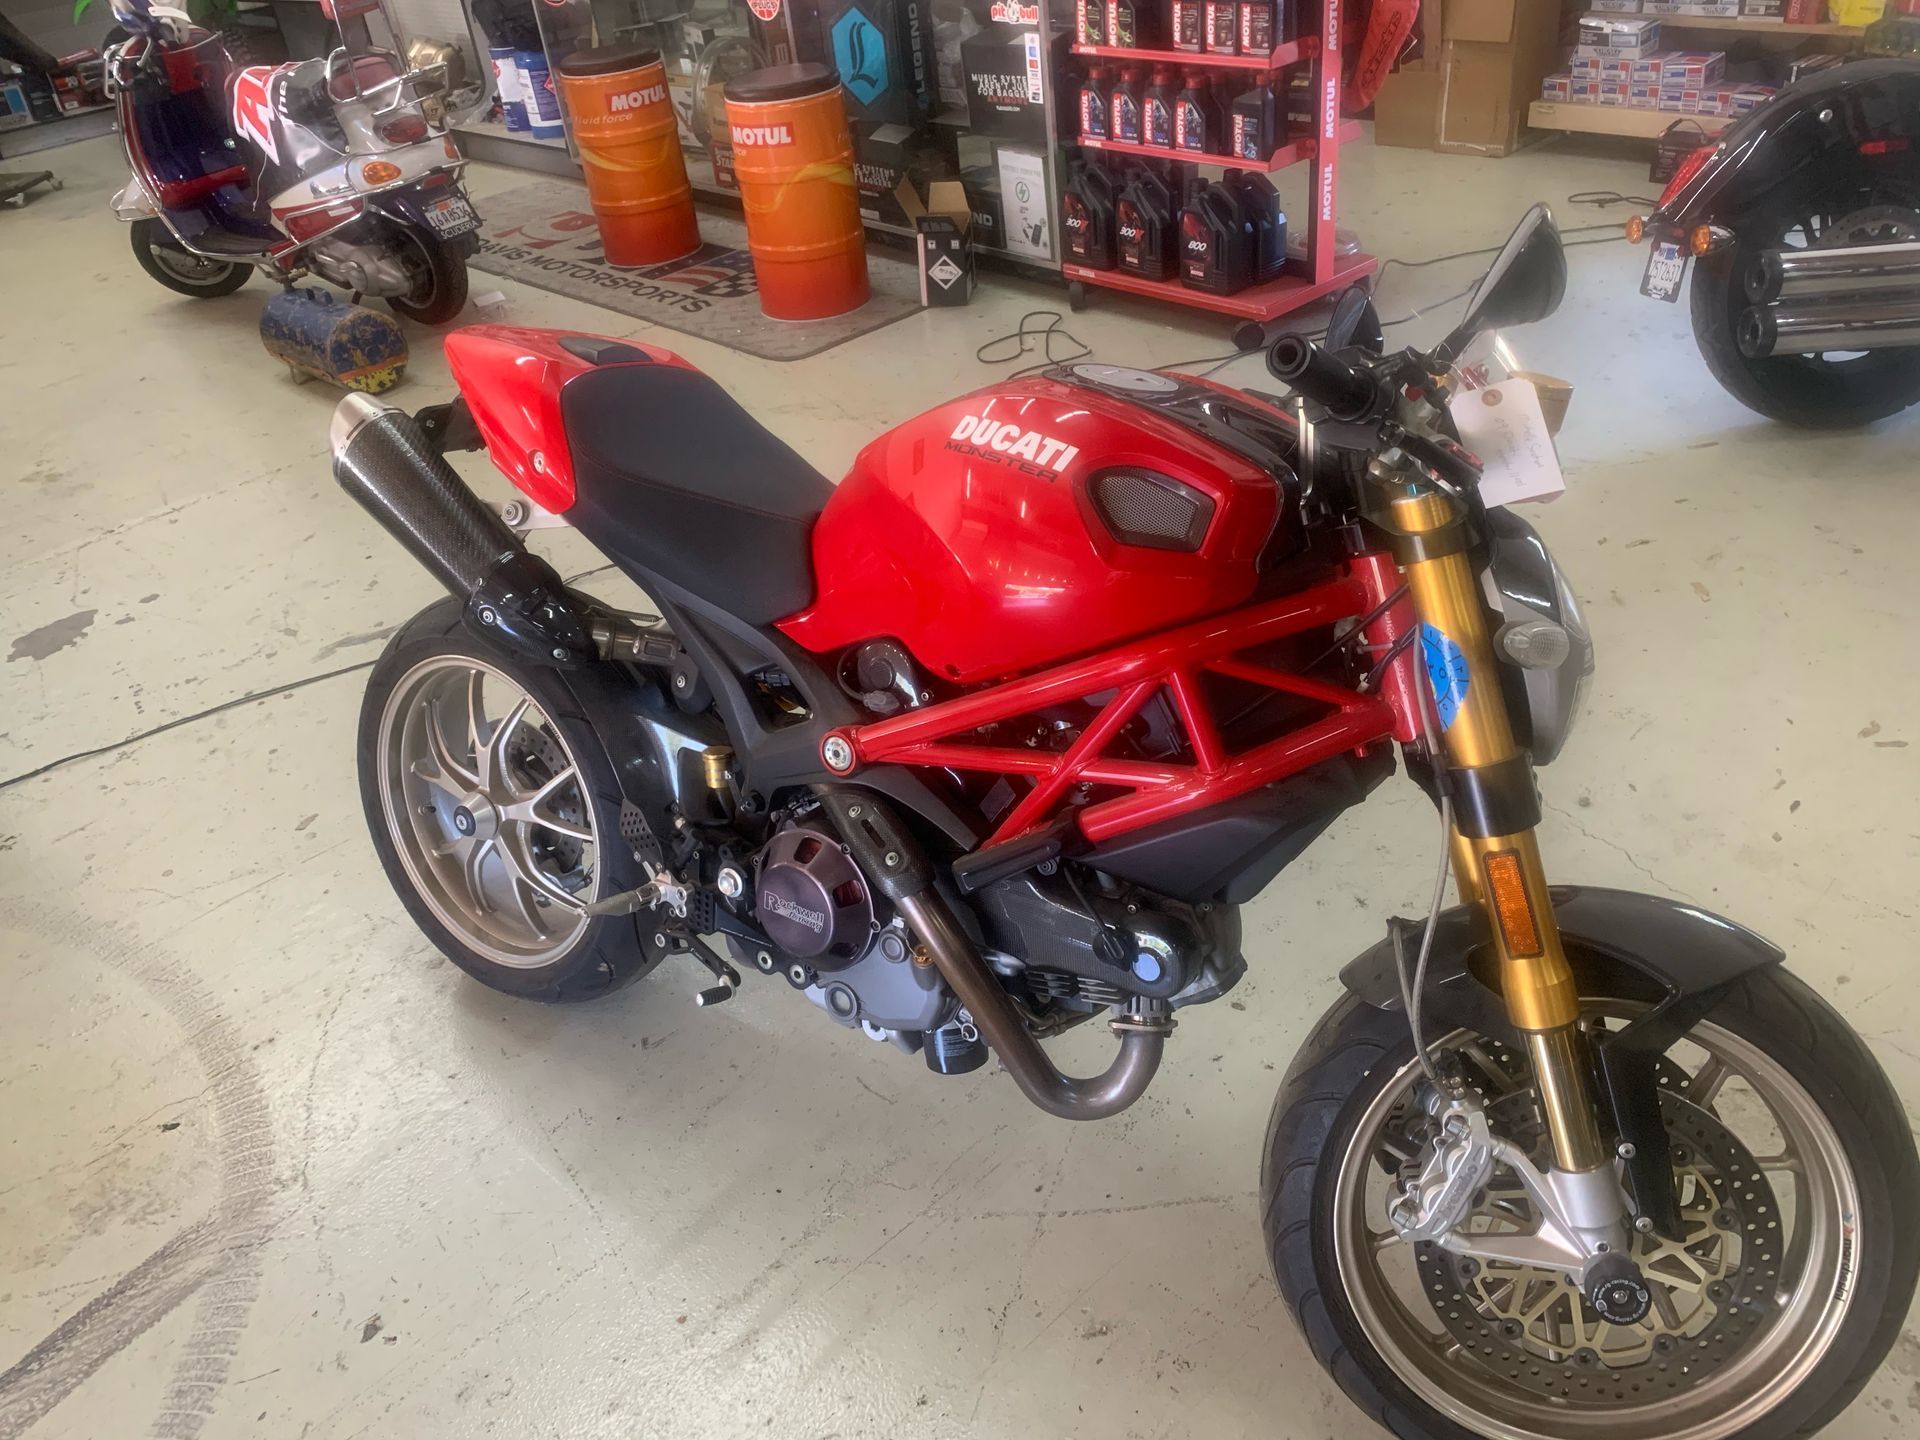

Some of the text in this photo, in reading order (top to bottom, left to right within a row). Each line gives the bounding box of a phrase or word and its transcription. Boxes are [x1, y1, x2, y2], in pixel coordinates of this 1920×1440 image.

[1109, 2, 1117, 47] MOTUL
[1207, 5, 1215, 45] MOTUL
[1242, 6, 1251, 47] MOTUL
[1328, 0, 1338, 50] MOTU
[611, 84, 666, 112] MOTUL
[1001, 75, 1027, 84] SYSTE
[1081, 95, 1090, 131] MOTUL
[1113, 97, 1122, 135] MOTUL
[1176, 107, 1185, 145] MOTUL
[1326, 77, 1336, 138] MOTUL
[732, 126, 792, 146] MOTUL
[1323, 163, 1333, 221] MOTUL
[441, 220, 479, 239] SCUDERIA
[478, 239, 713, 313] DAVIS MOTORSPORTS
[944, 441, 1058, 483] MONSTER
[950, 415, 1080, 473] DUCATI
[764, 890, 825, 923] Rockwell
